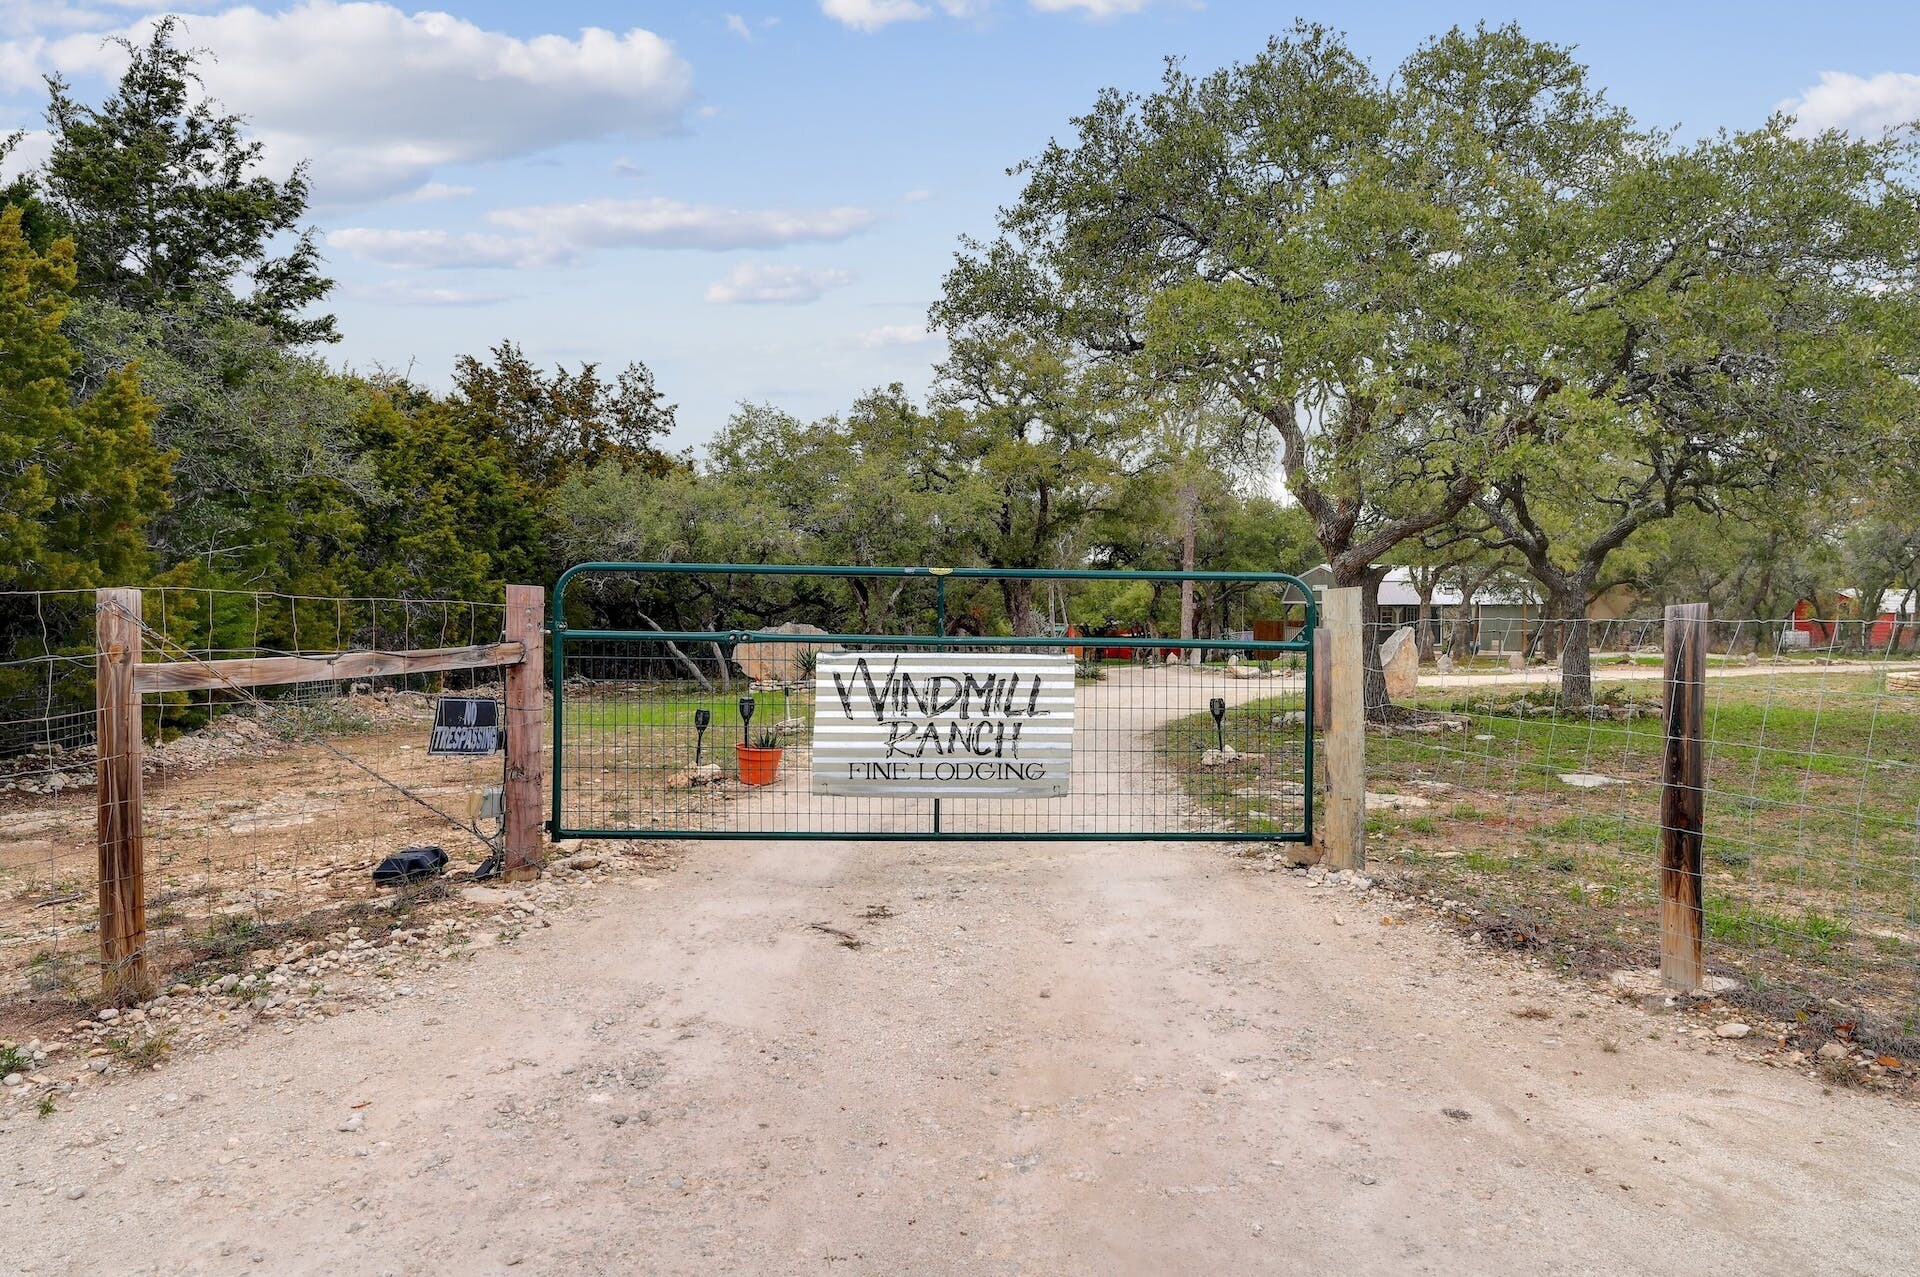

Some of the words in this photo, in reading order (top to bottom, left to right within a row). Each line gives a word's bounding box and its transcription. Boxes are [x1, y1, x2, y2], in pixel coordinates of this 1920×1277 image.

[833, 655, 1050, 721] WINDMILL
[464, 702, 477, 726] NO
[434, 726, 496, 749] TRESPASSING
[879, 720, 1022, 758] RANCH
[849, 762, 911, 780] FINE
[919, 762, 1046, 780] LODGING
